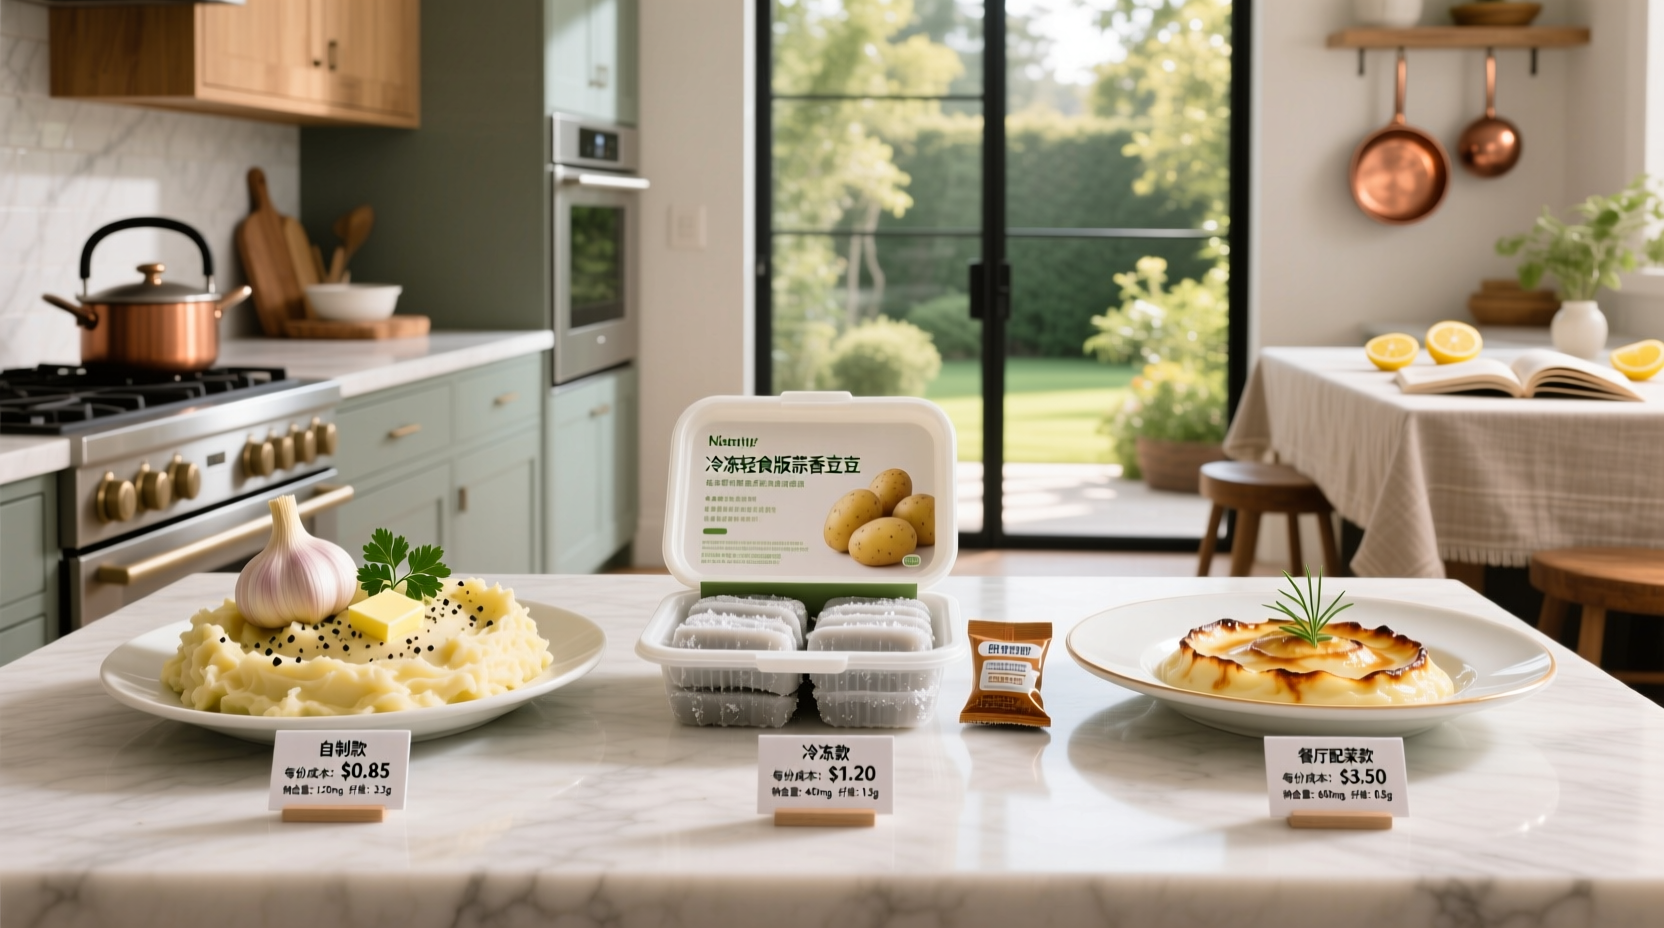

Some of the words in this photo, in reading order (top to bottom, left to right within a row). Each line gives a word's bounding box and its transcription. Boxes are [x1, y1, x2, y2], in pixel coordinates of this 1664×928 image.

[319, 740, 368, 758] 自制款
[802, 744, 851, 761] 冷冻款
[341, 761, 391, 781] $0.85
[828, 765, 877, 783] $1.20
[1340, 768, 1387, 785] $3.50
